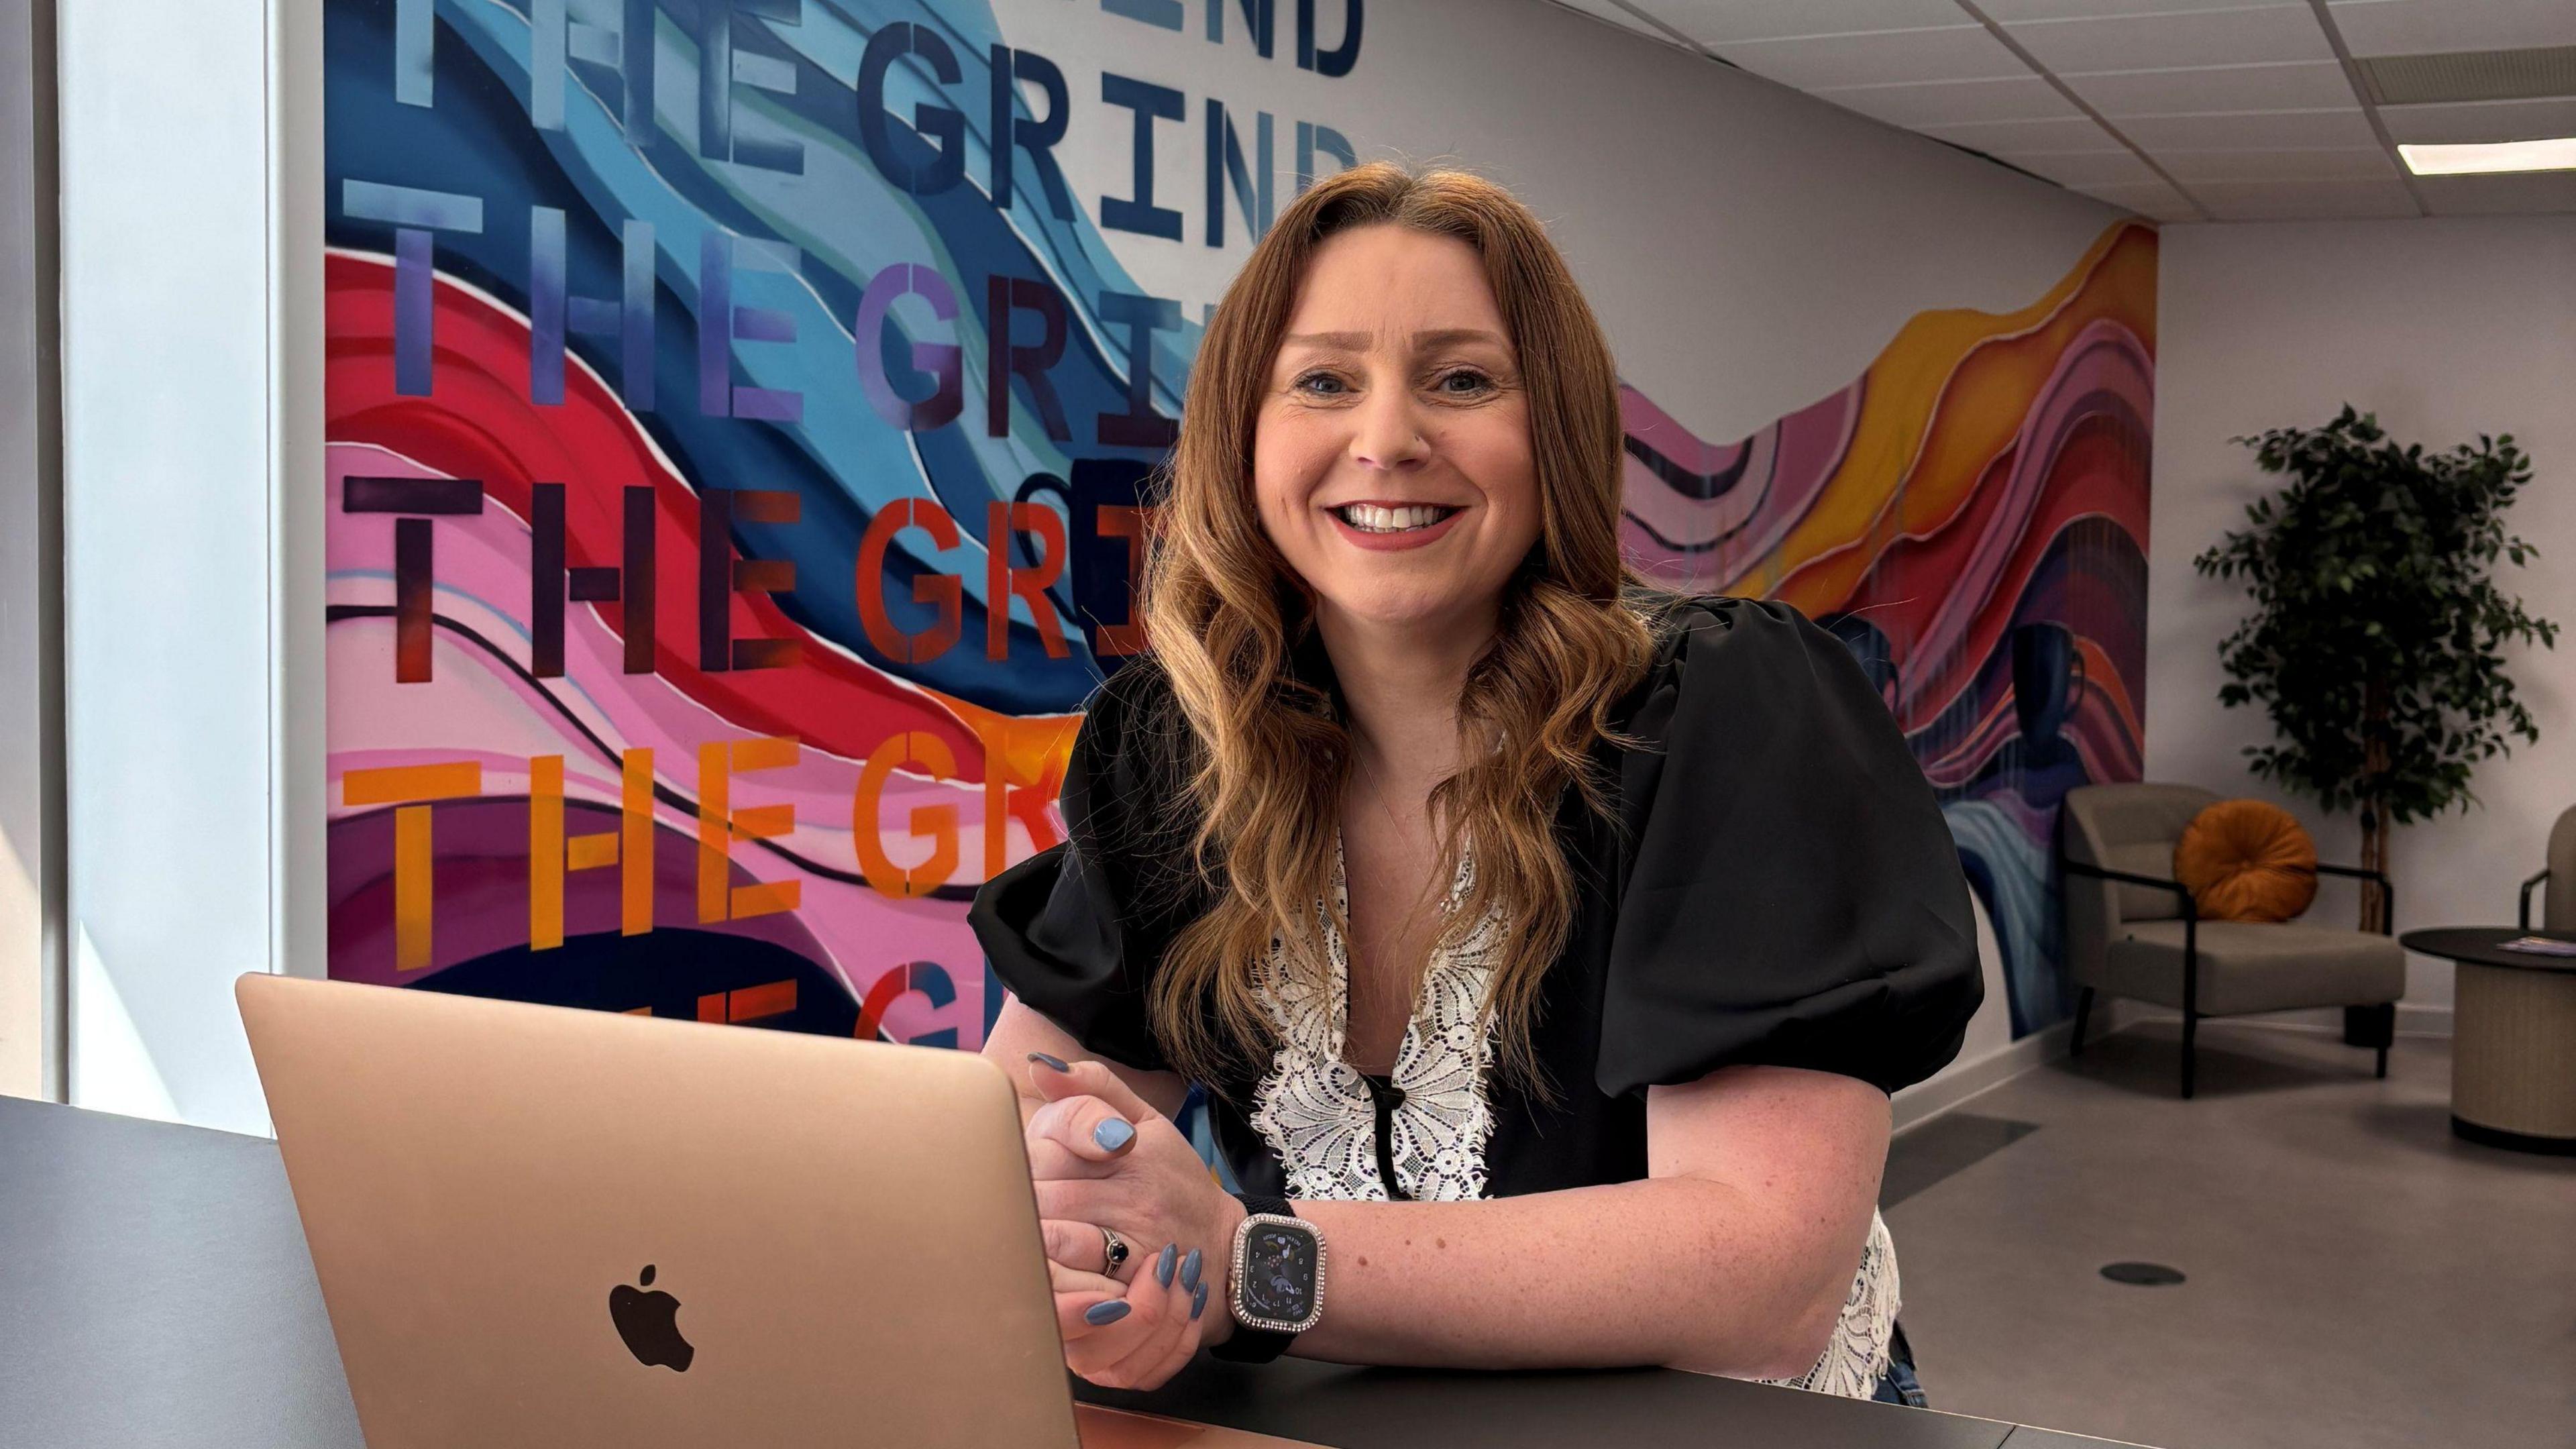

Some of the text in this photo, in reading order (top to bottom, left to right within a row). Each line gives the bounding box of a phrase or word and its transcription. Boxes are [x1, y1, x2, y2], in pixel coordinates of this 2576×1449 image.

[343, 179, 1218, 448] THE GRI
[343, 476, 1167, 683] THE GRI
[343, 736, 801, 971] THE
